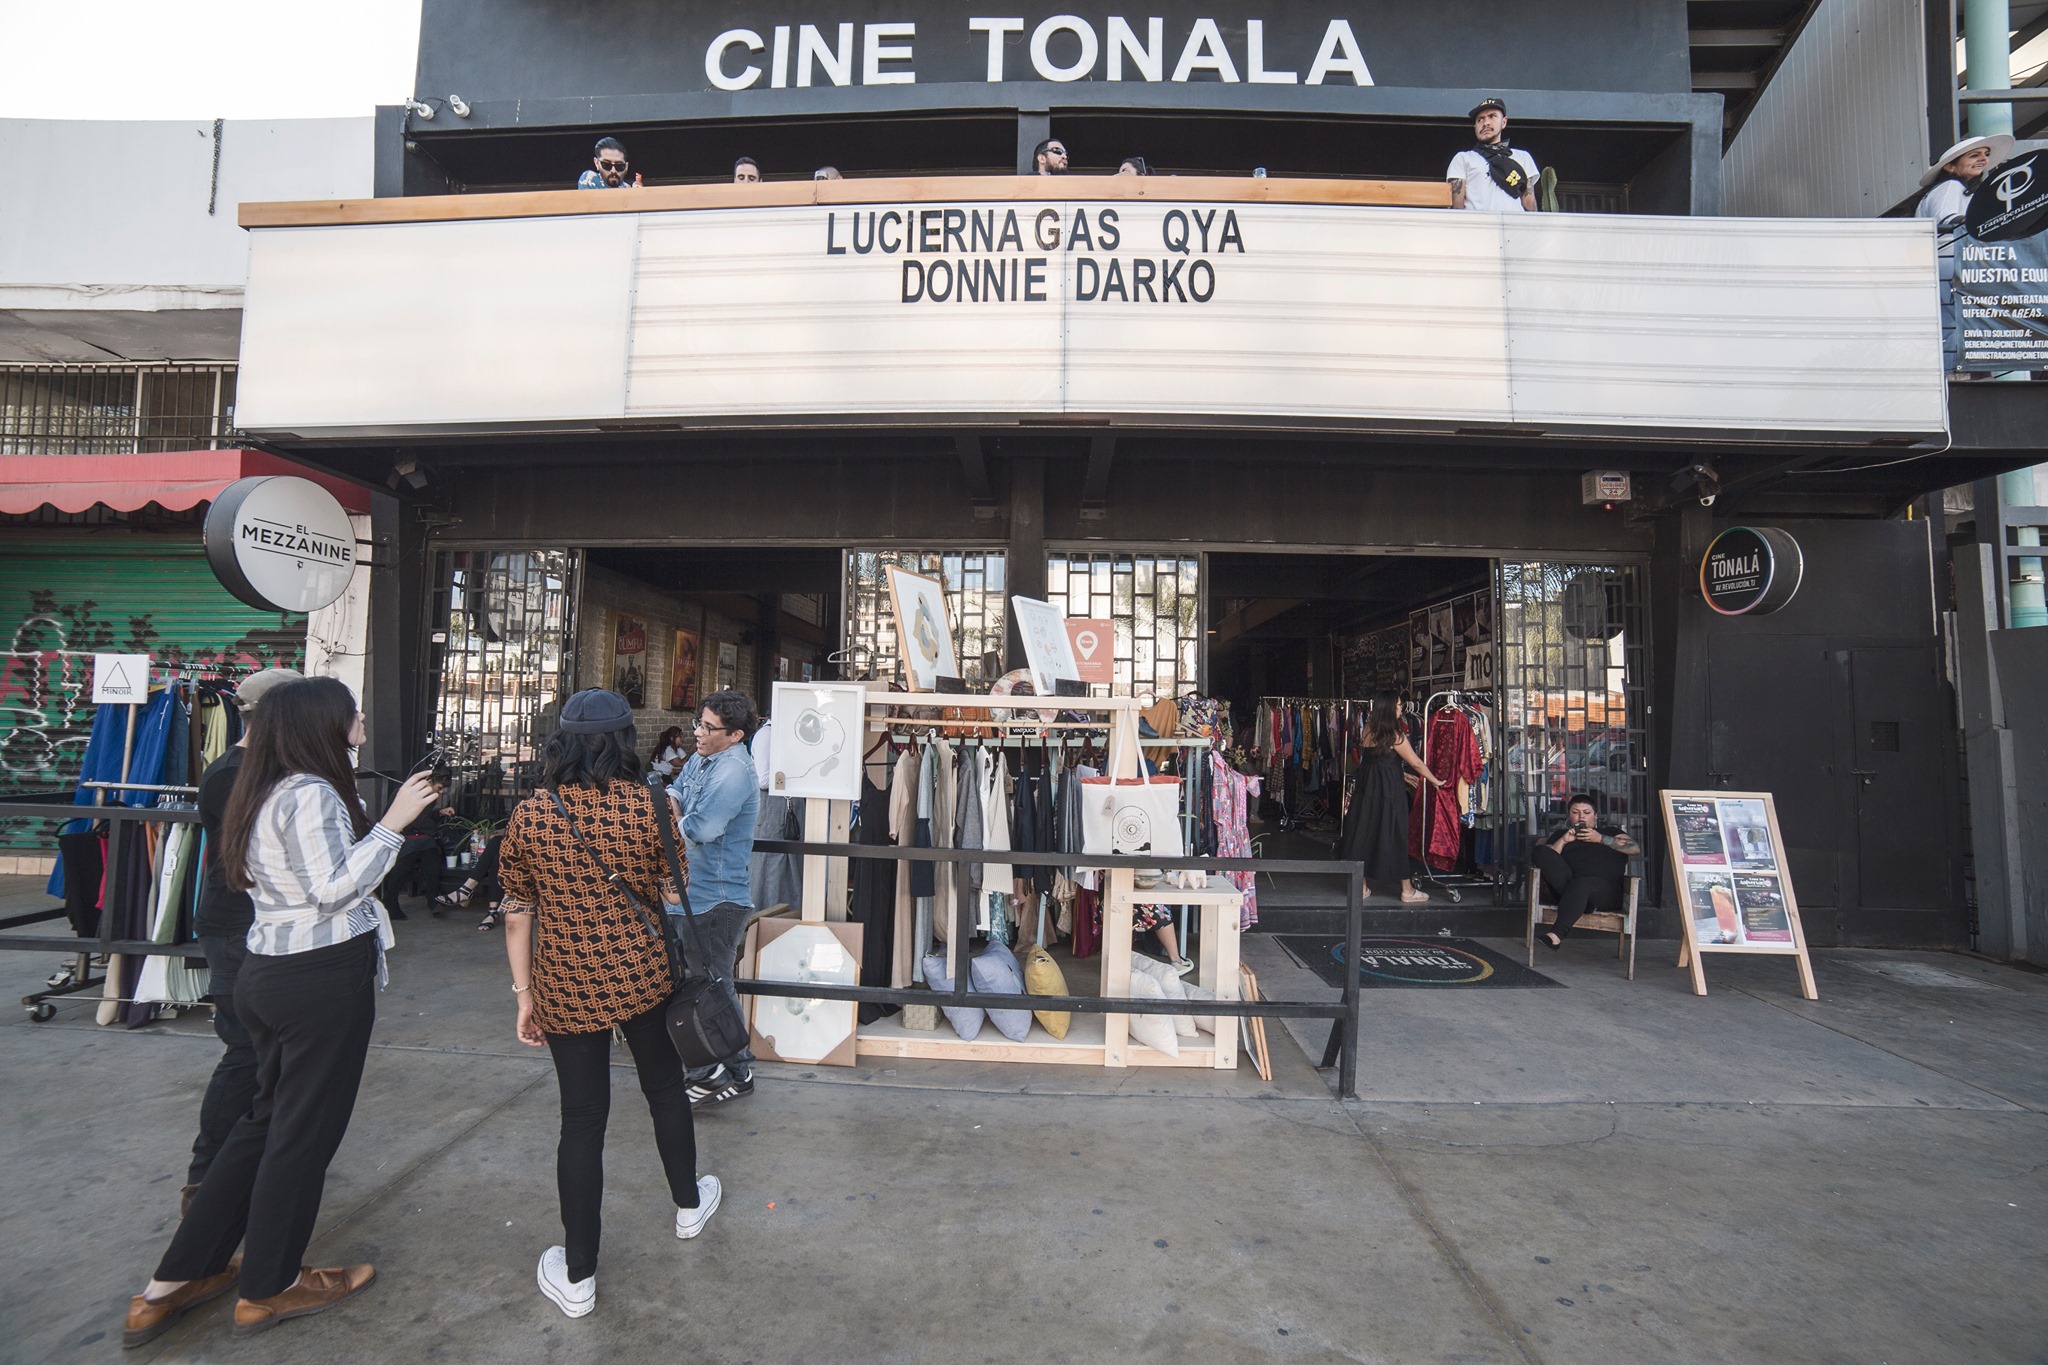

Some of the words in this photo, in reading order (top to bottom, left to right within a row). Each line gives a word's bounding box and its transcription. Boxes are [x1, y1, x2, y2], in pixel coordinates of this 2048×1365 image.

[705, 22, 916, 91] CINE
[968, 15, 1375, 87] TONALA
[1162, 208, 1245, 254] QYA
[2008, 246, 2017, 260] A
[901, 257, 1048, 304] DONNIE
[1075, 257, 1216, 303] DARKO
[1961, 267, 2018, 284] NUESTRO
[1961, 295, 2000, 306] ESTAMOS
[1983, 329, 1992, 338] TU
[1992, 329, 2024, 338] SOLICITUD
[296, 524, 310, 536] EL
[242, 524, 351, 562] MEZZANINE
[1711, 553, 1725, 561] CINE
[1711, 548, 1760, 579] TONALÁ
